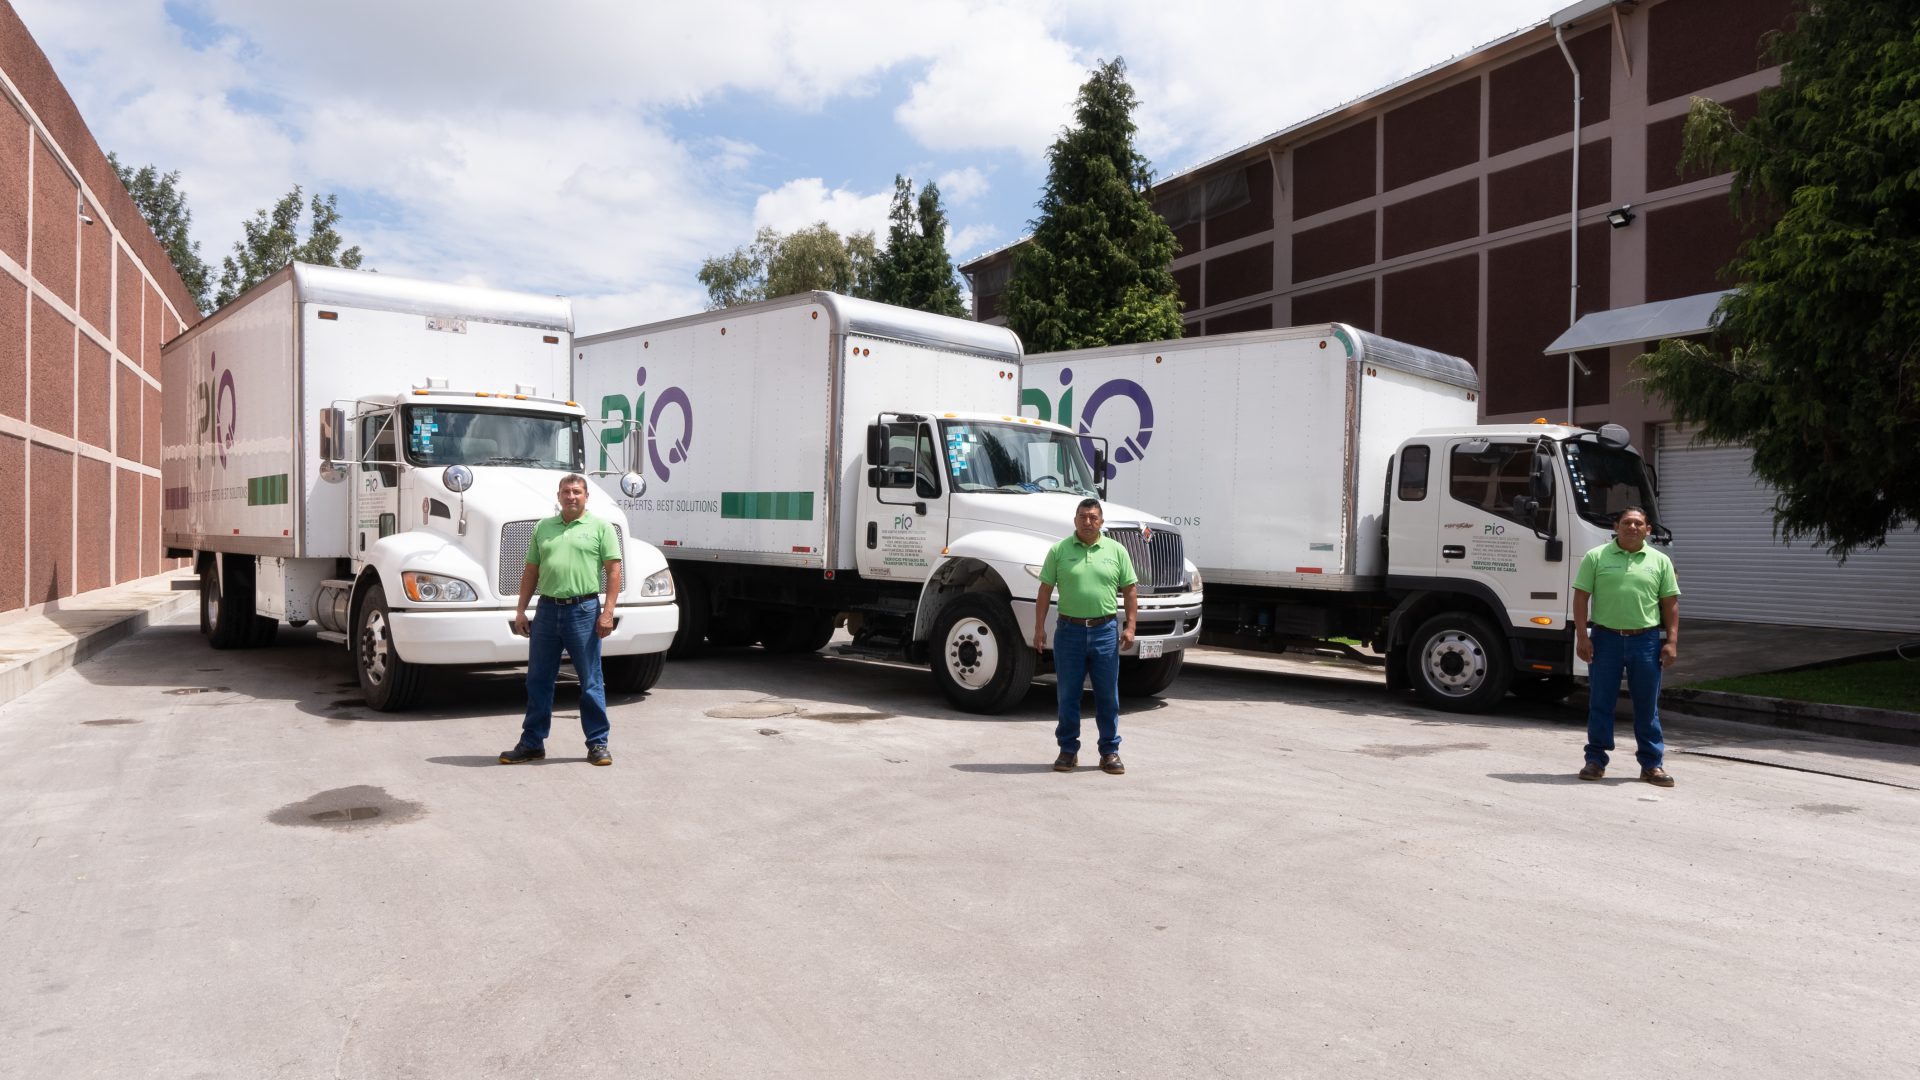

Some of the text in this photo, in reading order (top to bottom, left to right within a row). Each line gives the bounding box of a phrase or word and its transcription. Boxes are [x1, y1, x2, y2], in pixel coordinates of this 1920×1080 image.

[624, 499, 655, 512] EXPERTS,
[656, 500, 674, 512] BEST
[676, 500, 718, 512] SOLUTIONS
[1161, 516, 1200, 526] TIONS
